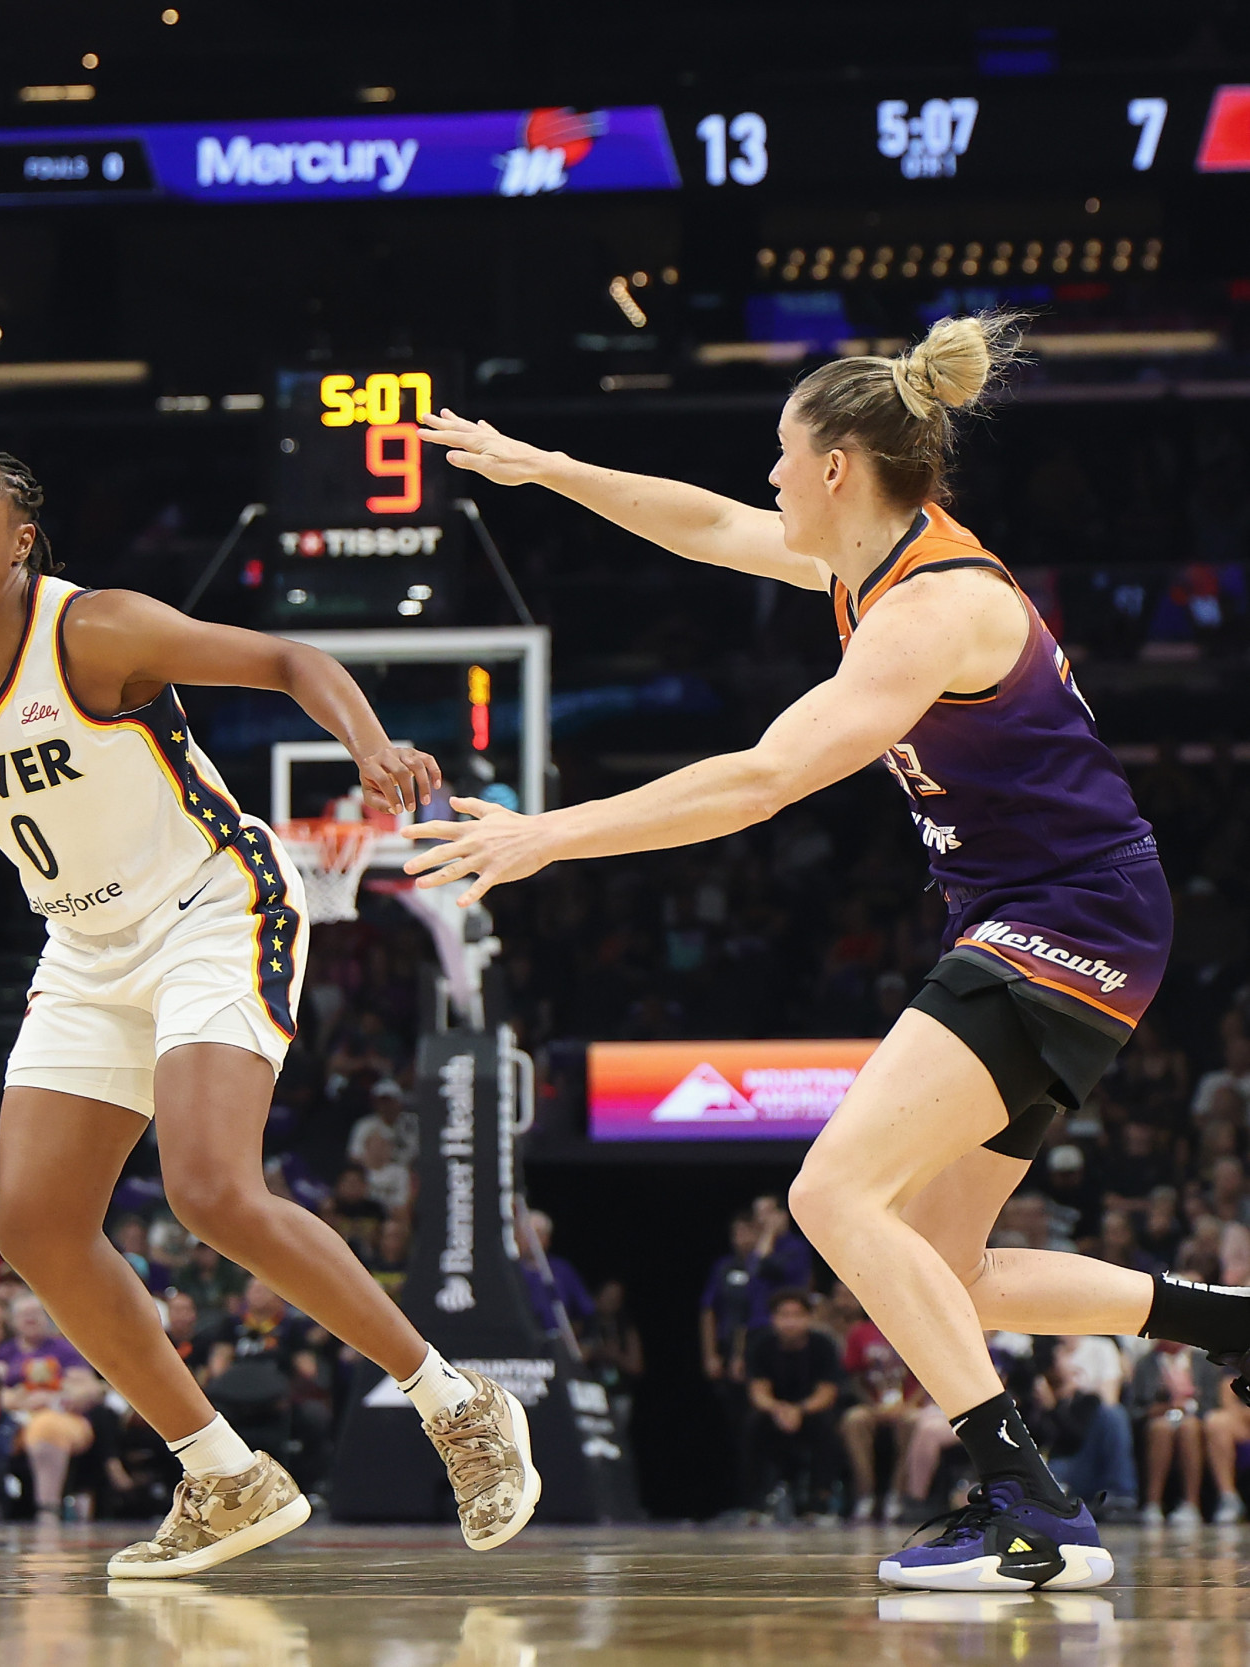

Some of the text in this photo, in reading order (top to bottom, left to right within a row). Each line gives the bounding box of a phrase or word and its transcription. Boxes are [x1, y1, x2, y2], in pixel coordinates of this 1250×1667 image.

[696, 112, 769, 186] 13
[876, 97, 979, 159] 5:07
[1127, 97, 1168, 171] 7
[196, 135, 419, 192] Mercury
[320, 372, 432, 427] 5:07
[365, 422, 422, 514] 9
[21, 702, 60, 725] Lilly
[10, 813, 60, 881] 0
[29, 882, 124, 917] alesforce
[970, 920, 1129, 993] Mercury
[438, 1053, 475, 1273] Banner Health
